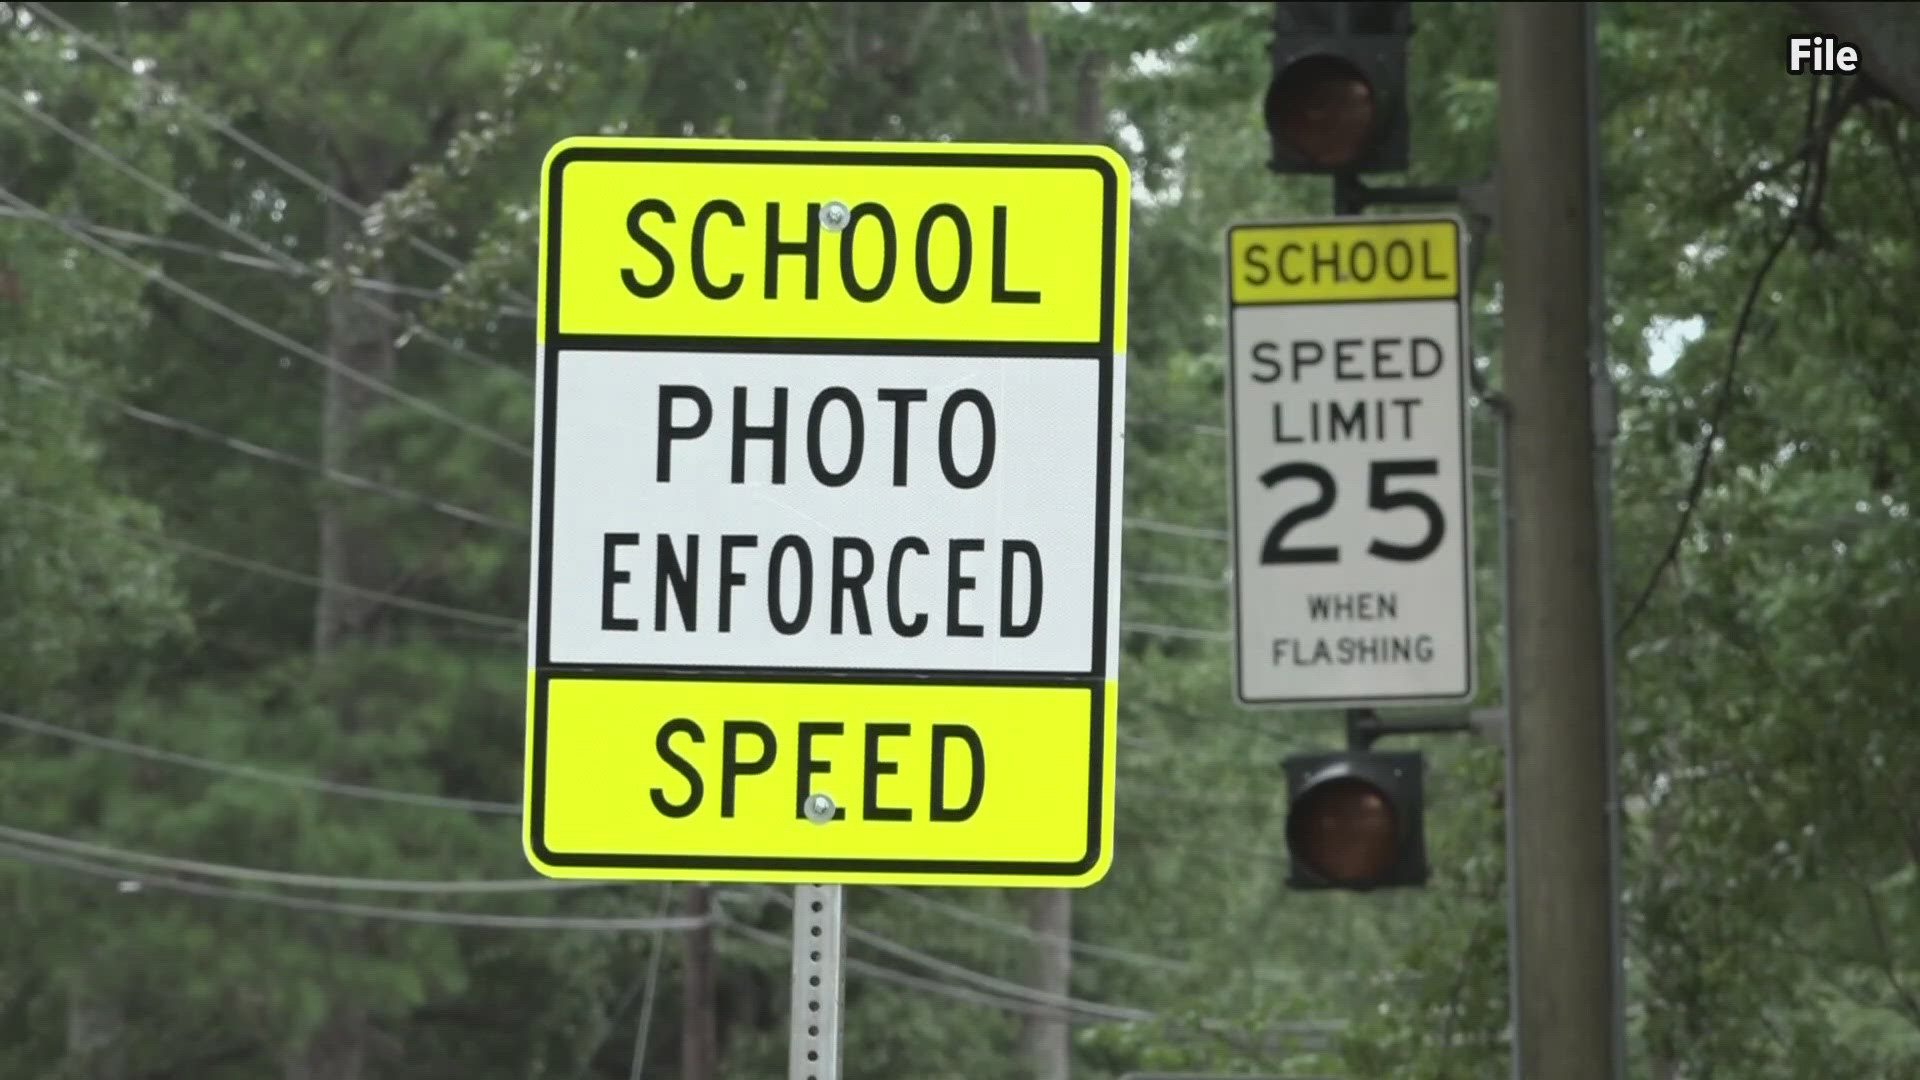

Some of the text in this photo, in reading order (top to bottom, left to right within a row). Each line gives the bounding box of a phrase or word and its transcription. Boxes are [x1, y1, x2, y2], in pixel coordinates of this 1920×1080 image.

[620, 198, 1041, 304] SCHOOL
[1243, 238, 1448, 286] SCHOOL
[1250, 337, 1444, 384] SPEED
[655, 384, 997, 490] PHOTO
[1272, 398, 1421, 444] LIMIT
[1258, 458, 1446, 567] 25
[600, 532, 1044, 638] ENFORCED
[1308, 593, 1398, 621] WHEN
[1272, 635, 1434, 666] FLASHING
[648, 717, 986, 823] SPEED
